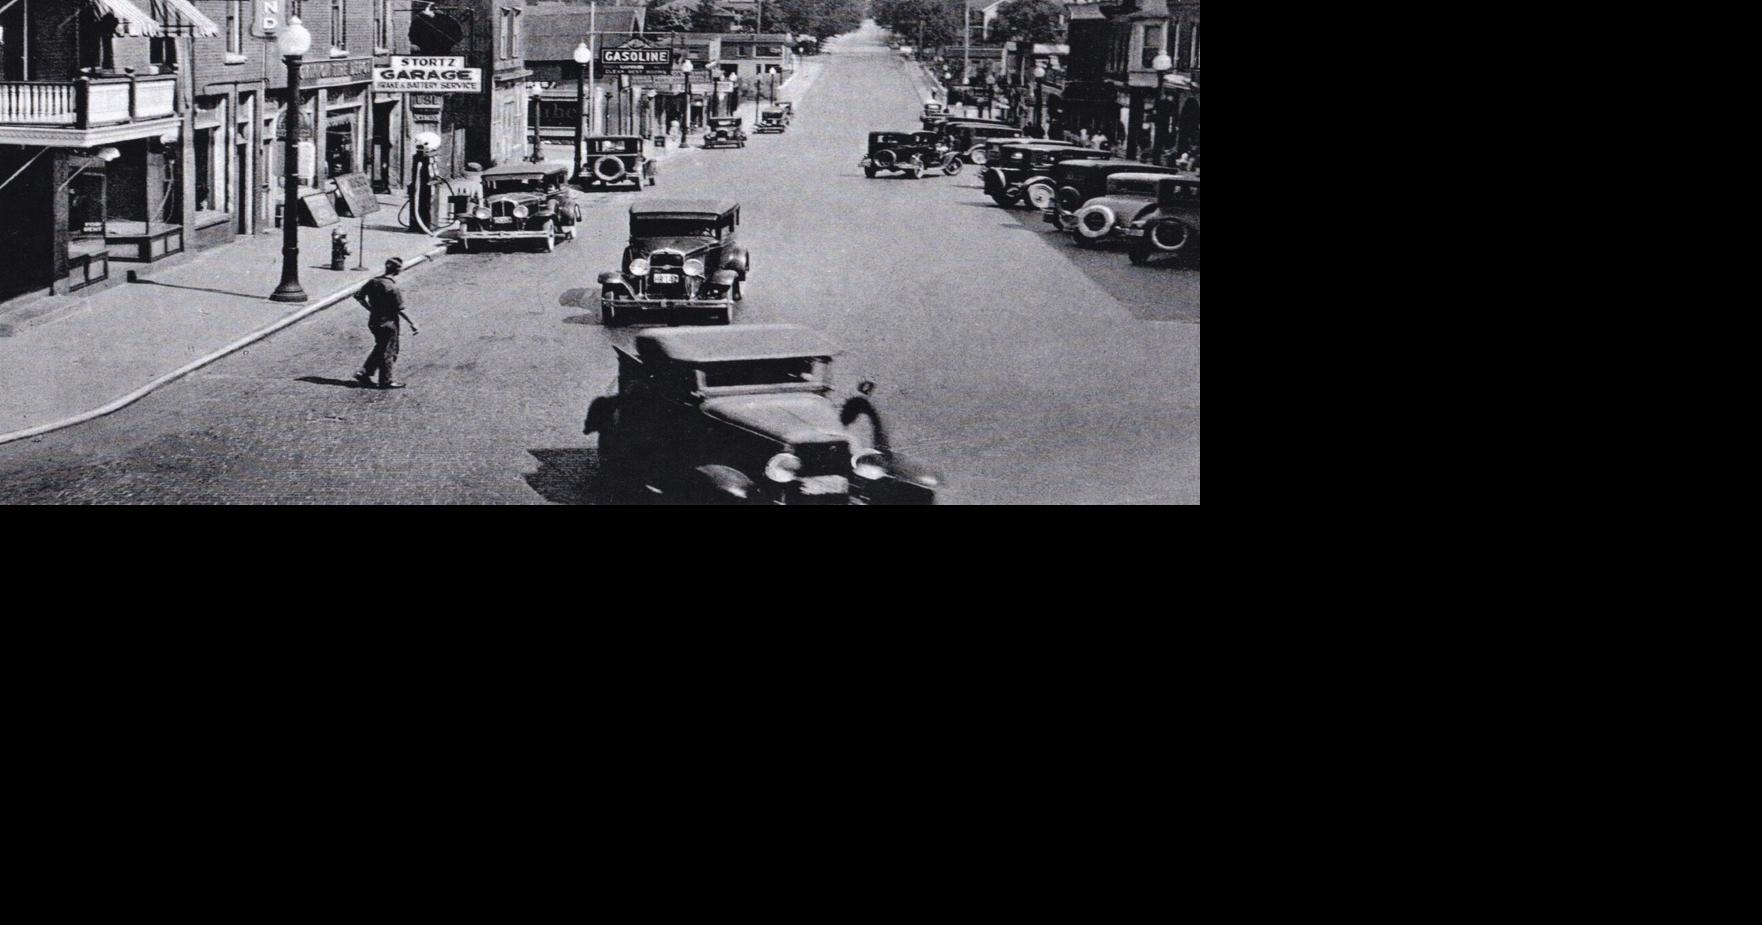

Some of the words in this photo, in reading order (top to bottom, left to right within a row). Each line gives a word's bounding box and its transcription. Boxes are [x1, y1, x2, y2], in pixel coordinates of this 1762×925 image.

[604, 51, 668, 62] GASOLINE
[401, 58, 457, 67] STORTZ
[380, 69, 473, 81] GARAGE
[377, 81, 399, 89] BRAKE
[407, 82, 438, 90] BATTERY
[440, 82, 478, 90] SERVICE
